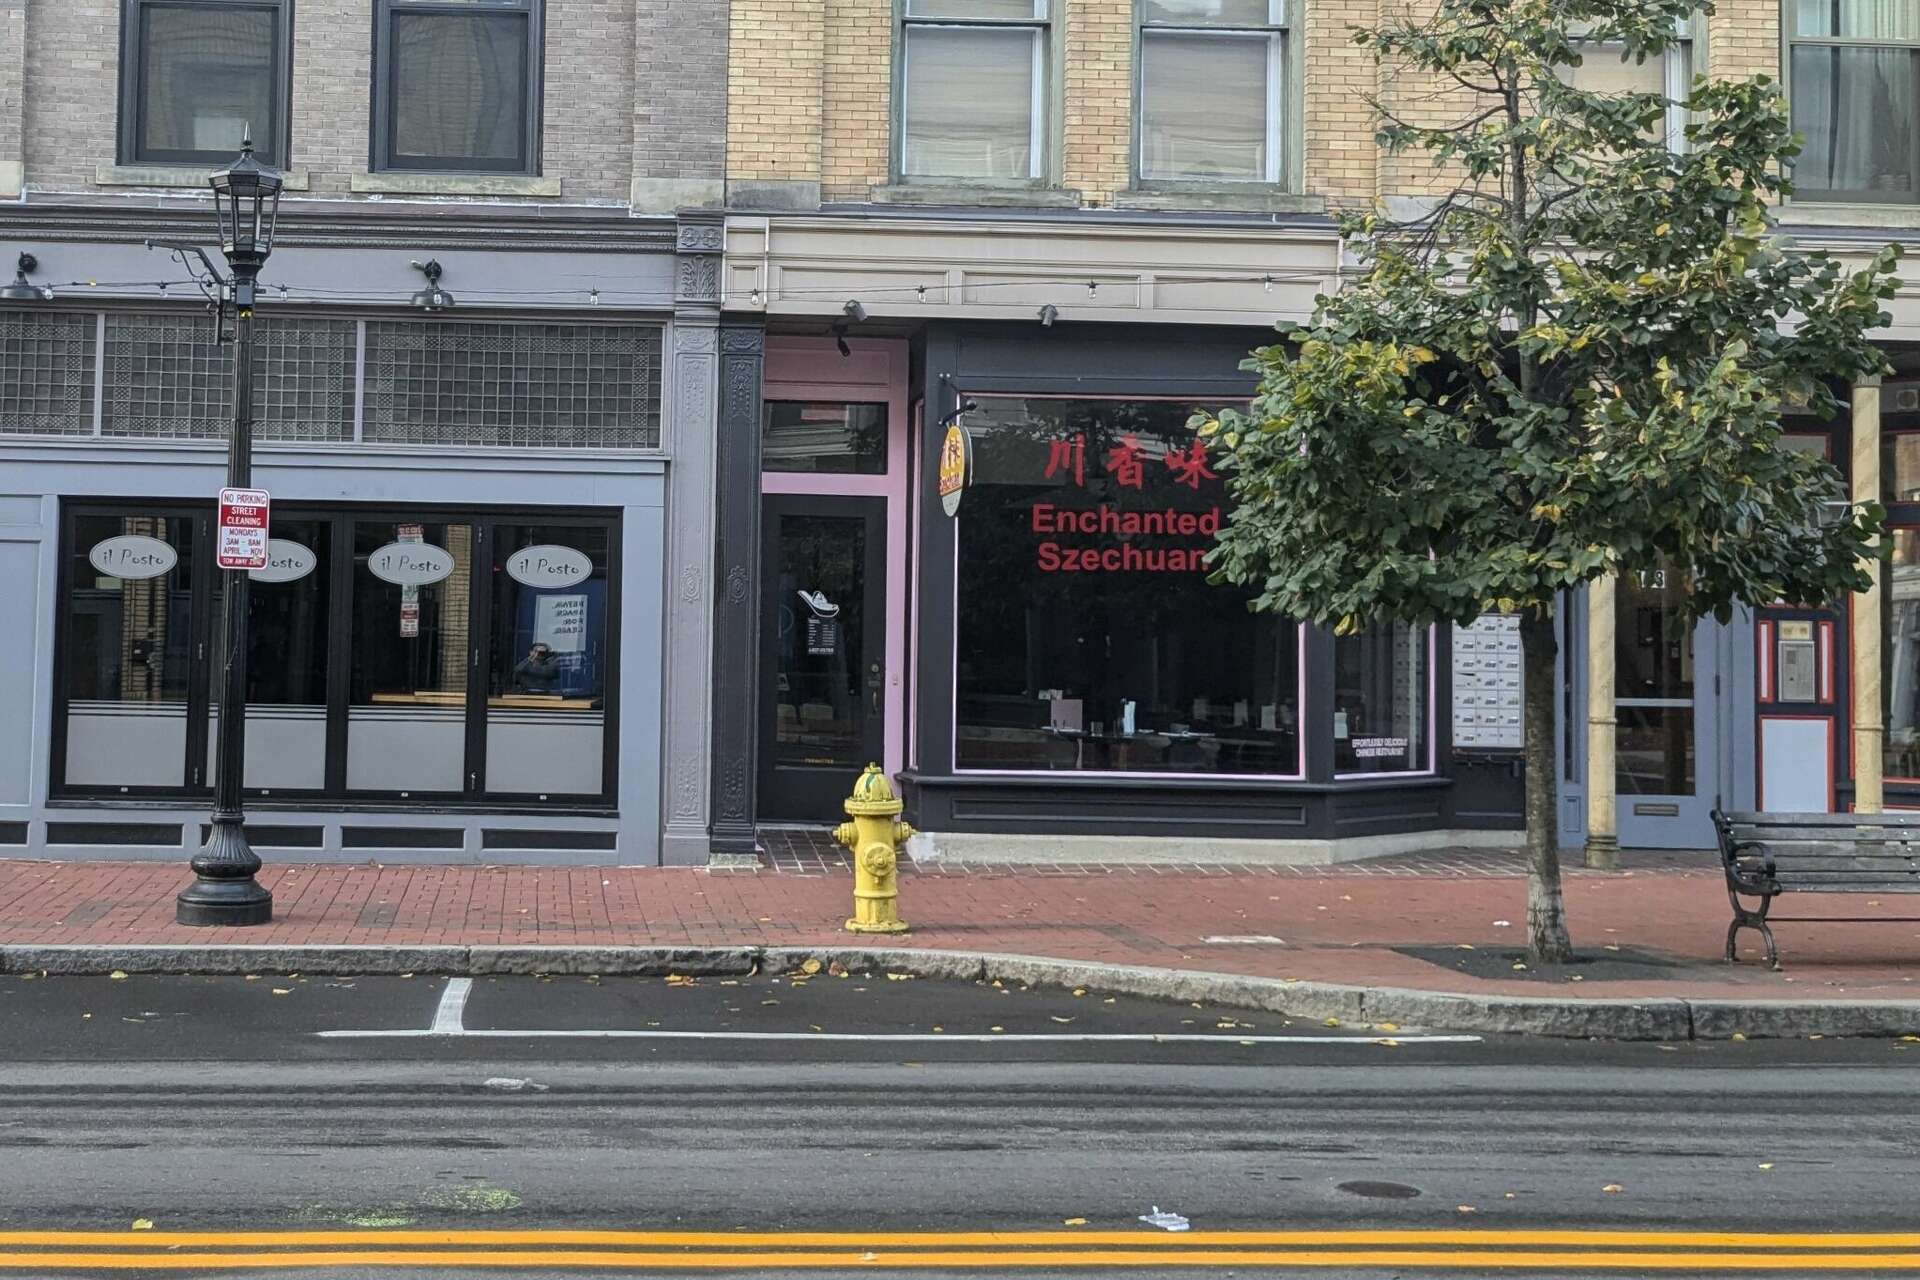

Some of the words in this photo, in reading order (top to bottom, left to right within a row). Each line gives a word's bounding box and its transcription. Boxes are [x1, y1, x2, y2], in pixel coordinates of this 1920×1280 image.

[1044, 432, 1219, 490] 川香味
[223, 493, 234, 503] NO
[236, 494, 266, 505] PARKING
[231, 506, 257, 516] STREET
[226, 517, 262, 526] CLEANING
[1032, 503, 1220, 535] Enchanted
[229, 528, 258, 537] MONDAYS
[120, 549, 164, 565] Posto
[223, 546, 240, 555] APRIL
[399, 556, 441, 572] Posto
[537, 558, 579, 575] Posto
